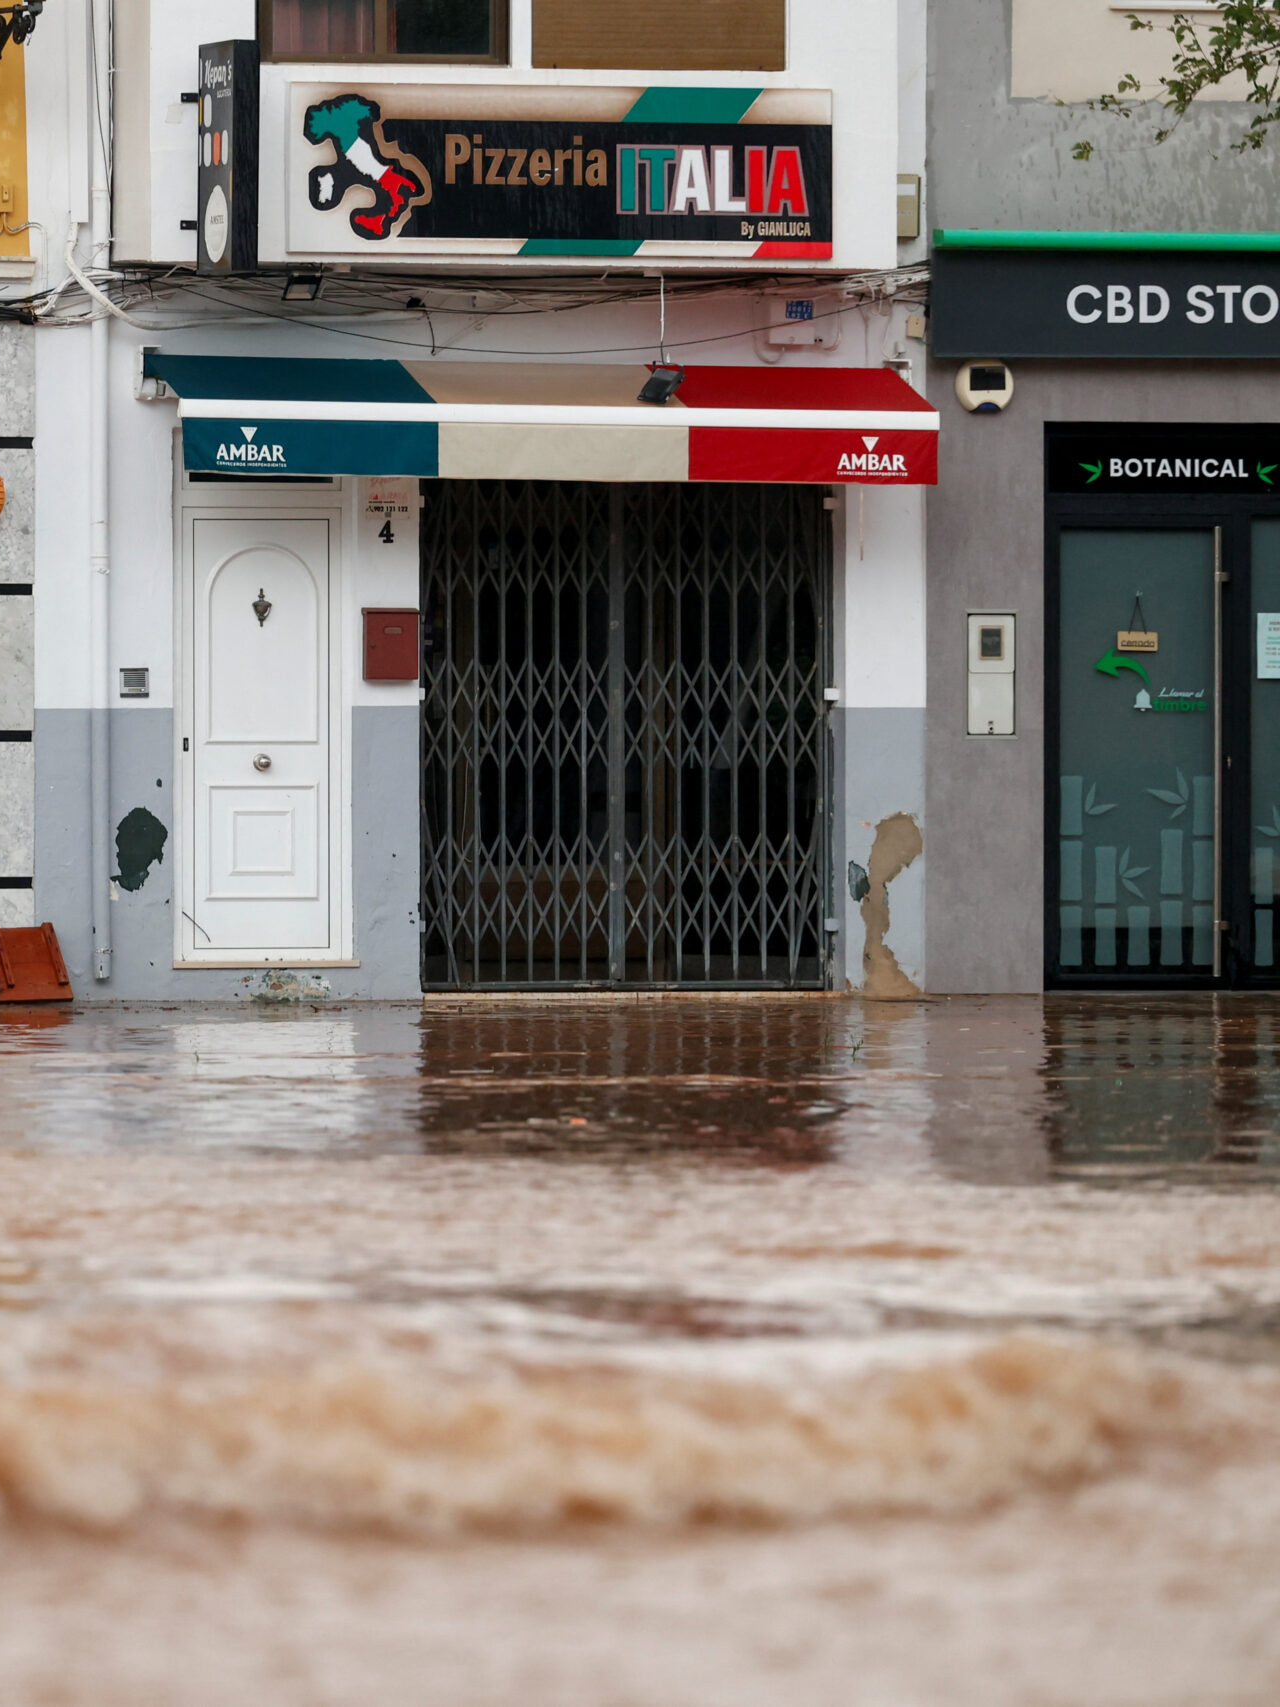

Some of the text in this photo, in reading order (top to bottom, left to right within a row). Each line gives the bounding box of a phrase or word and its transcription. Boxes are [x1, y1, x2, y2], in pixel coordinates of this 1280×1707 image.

[444, 133, 809, 216] Pizzeria ITALIA
[740, 221, 811, 239] By GIANLUCA
[1066, 284, 1170, 324] CBD
[216, 443, 287, 462] AMBAR
[837, 453, 907, 471] AMBAR
[1109, 458, 1249, 478] BOTANICAL
[378, 519, 395, 544] 4
[1153, 697, 1206, 712] timbre
